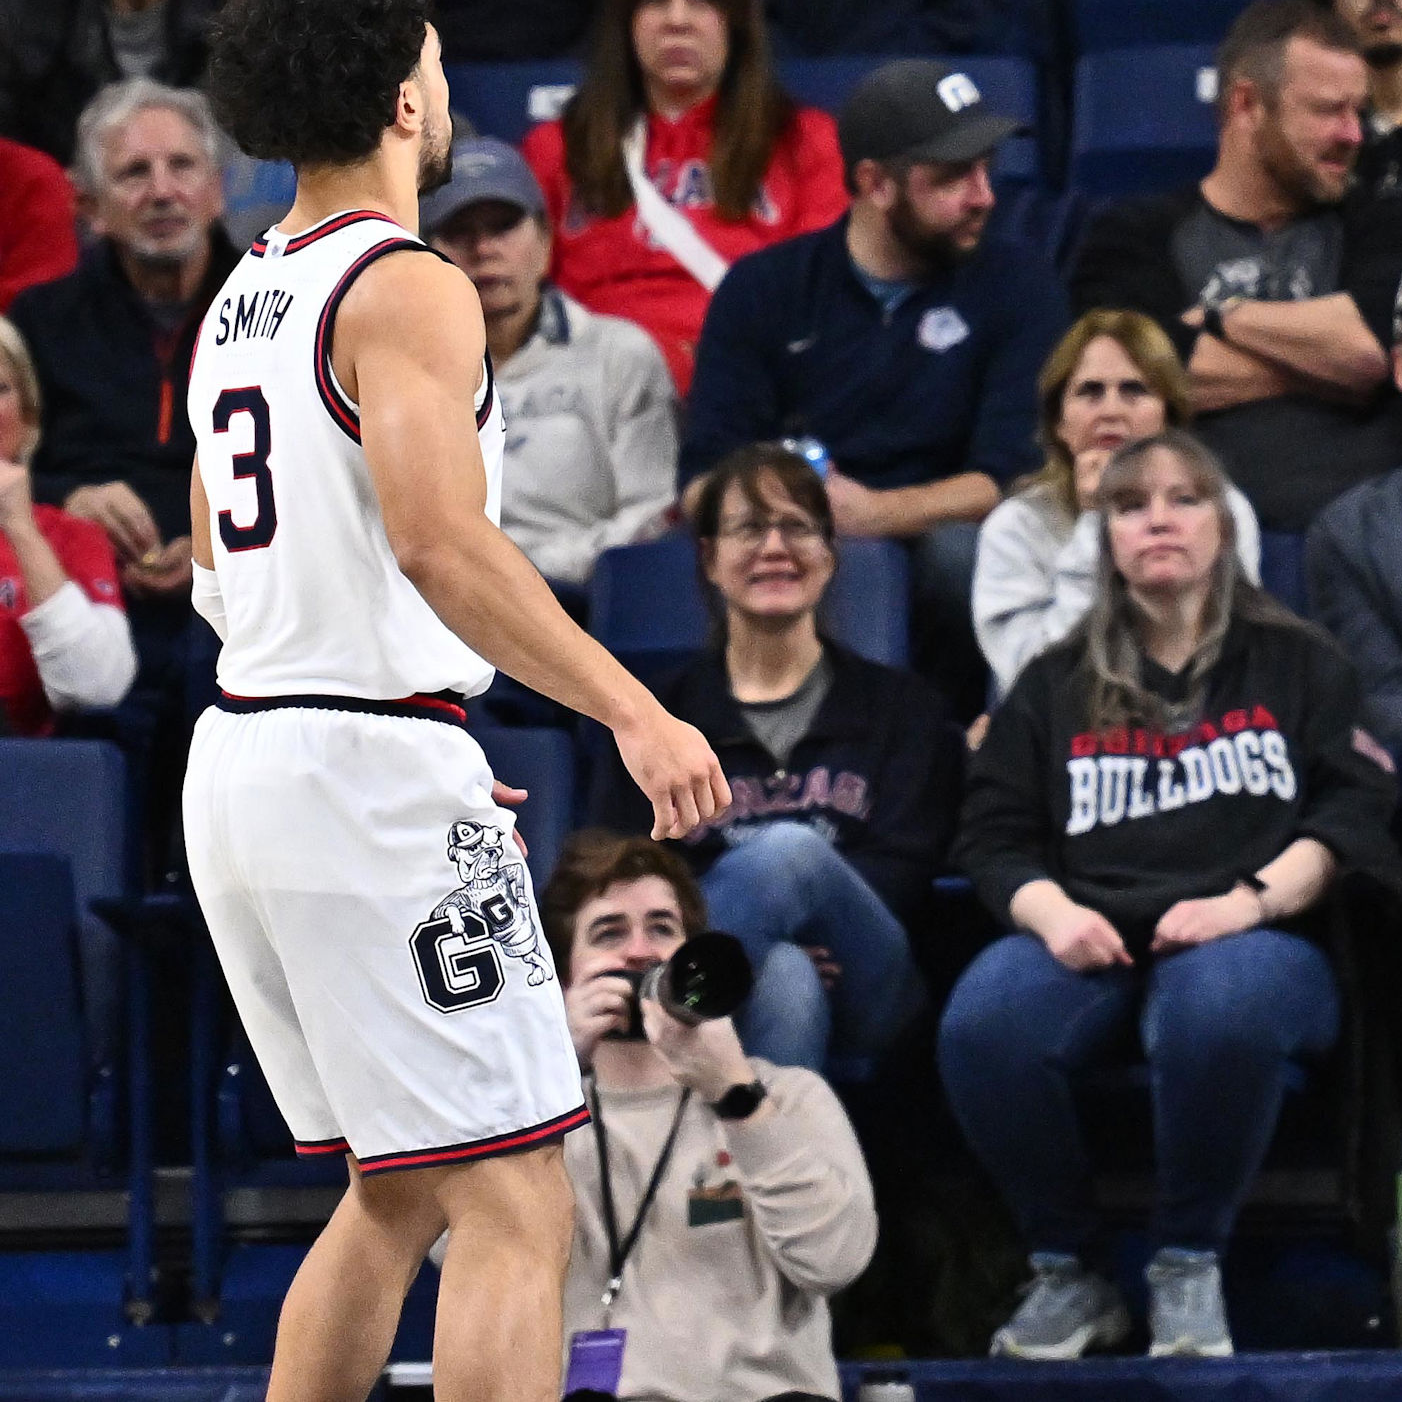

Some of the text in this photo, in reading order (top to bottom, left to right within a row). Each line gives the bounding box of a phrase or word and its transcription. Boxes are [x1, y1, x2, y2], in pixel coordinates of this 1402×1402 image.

[216, 290, 294, 346] SMITH
[212, 385, 278, 553] 3
[1065, 729, 1298, 836] BULLDOGS
[480, 894, 514, 926] G
[409, 911, 505, 1014] G
